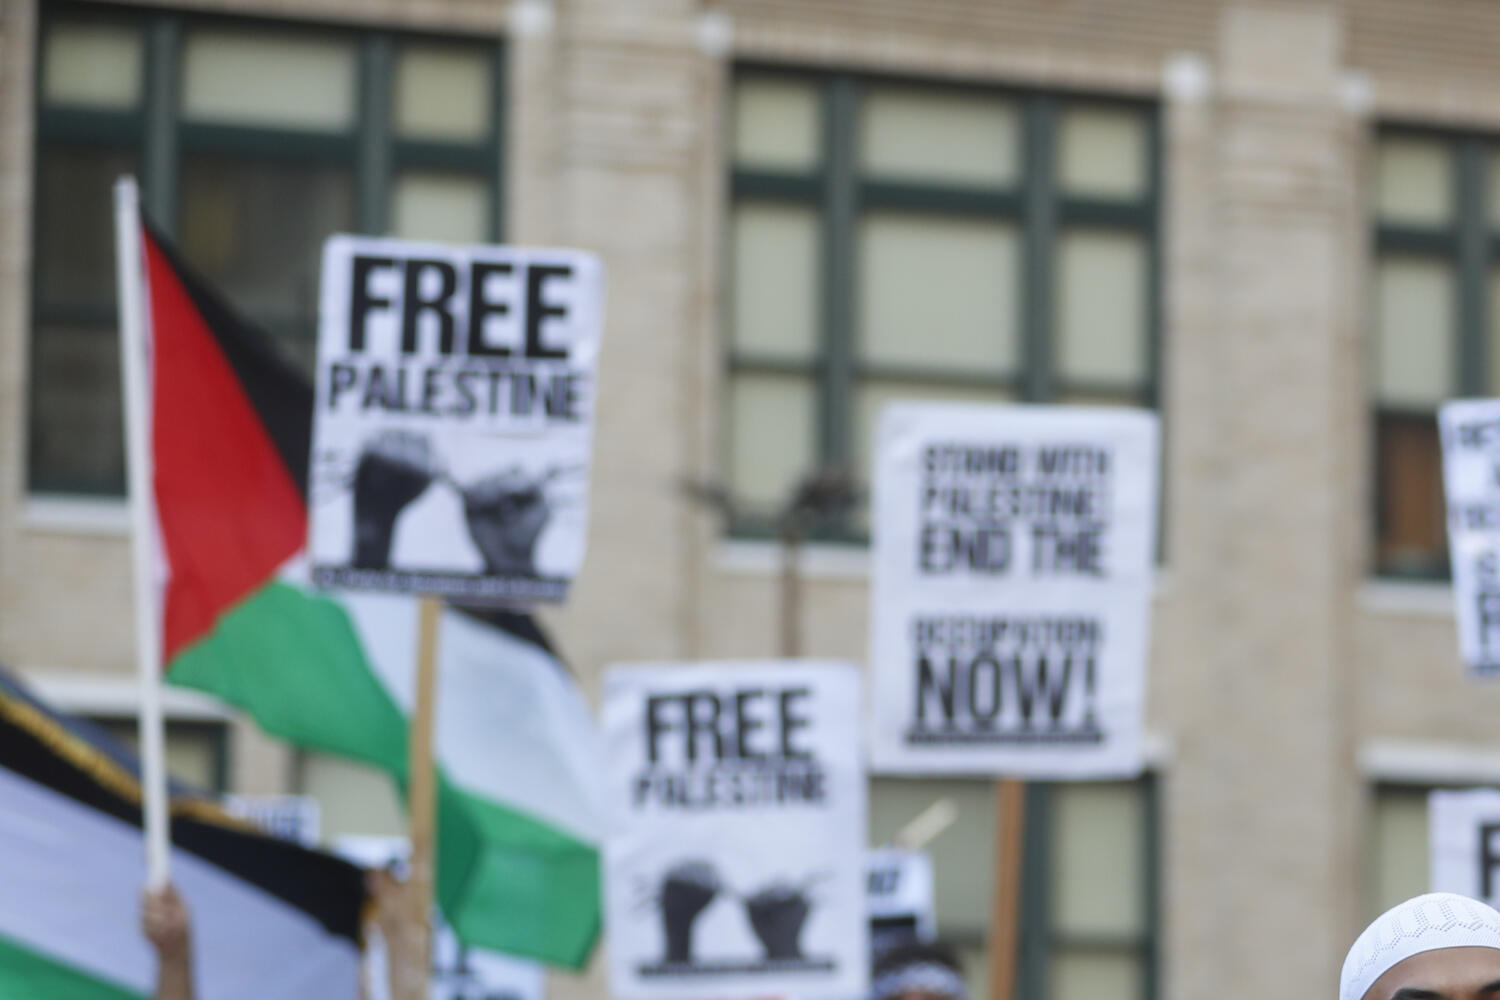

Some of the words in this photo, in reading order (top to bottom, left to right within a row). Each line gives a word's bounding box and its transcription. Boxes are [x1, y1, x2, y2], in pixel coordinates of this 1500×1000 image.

[349, 256, 574, 360] FREE
[326, 363, 583, 422] PALESTINE
[919, 521, 1014, 576] END
[1030, 524, 1106, 580] THE
[915, 655, 1098, 722] NOW!
[645, 686, 815, 764] FREE
[633, 768, 828, 810] PALESTINE
